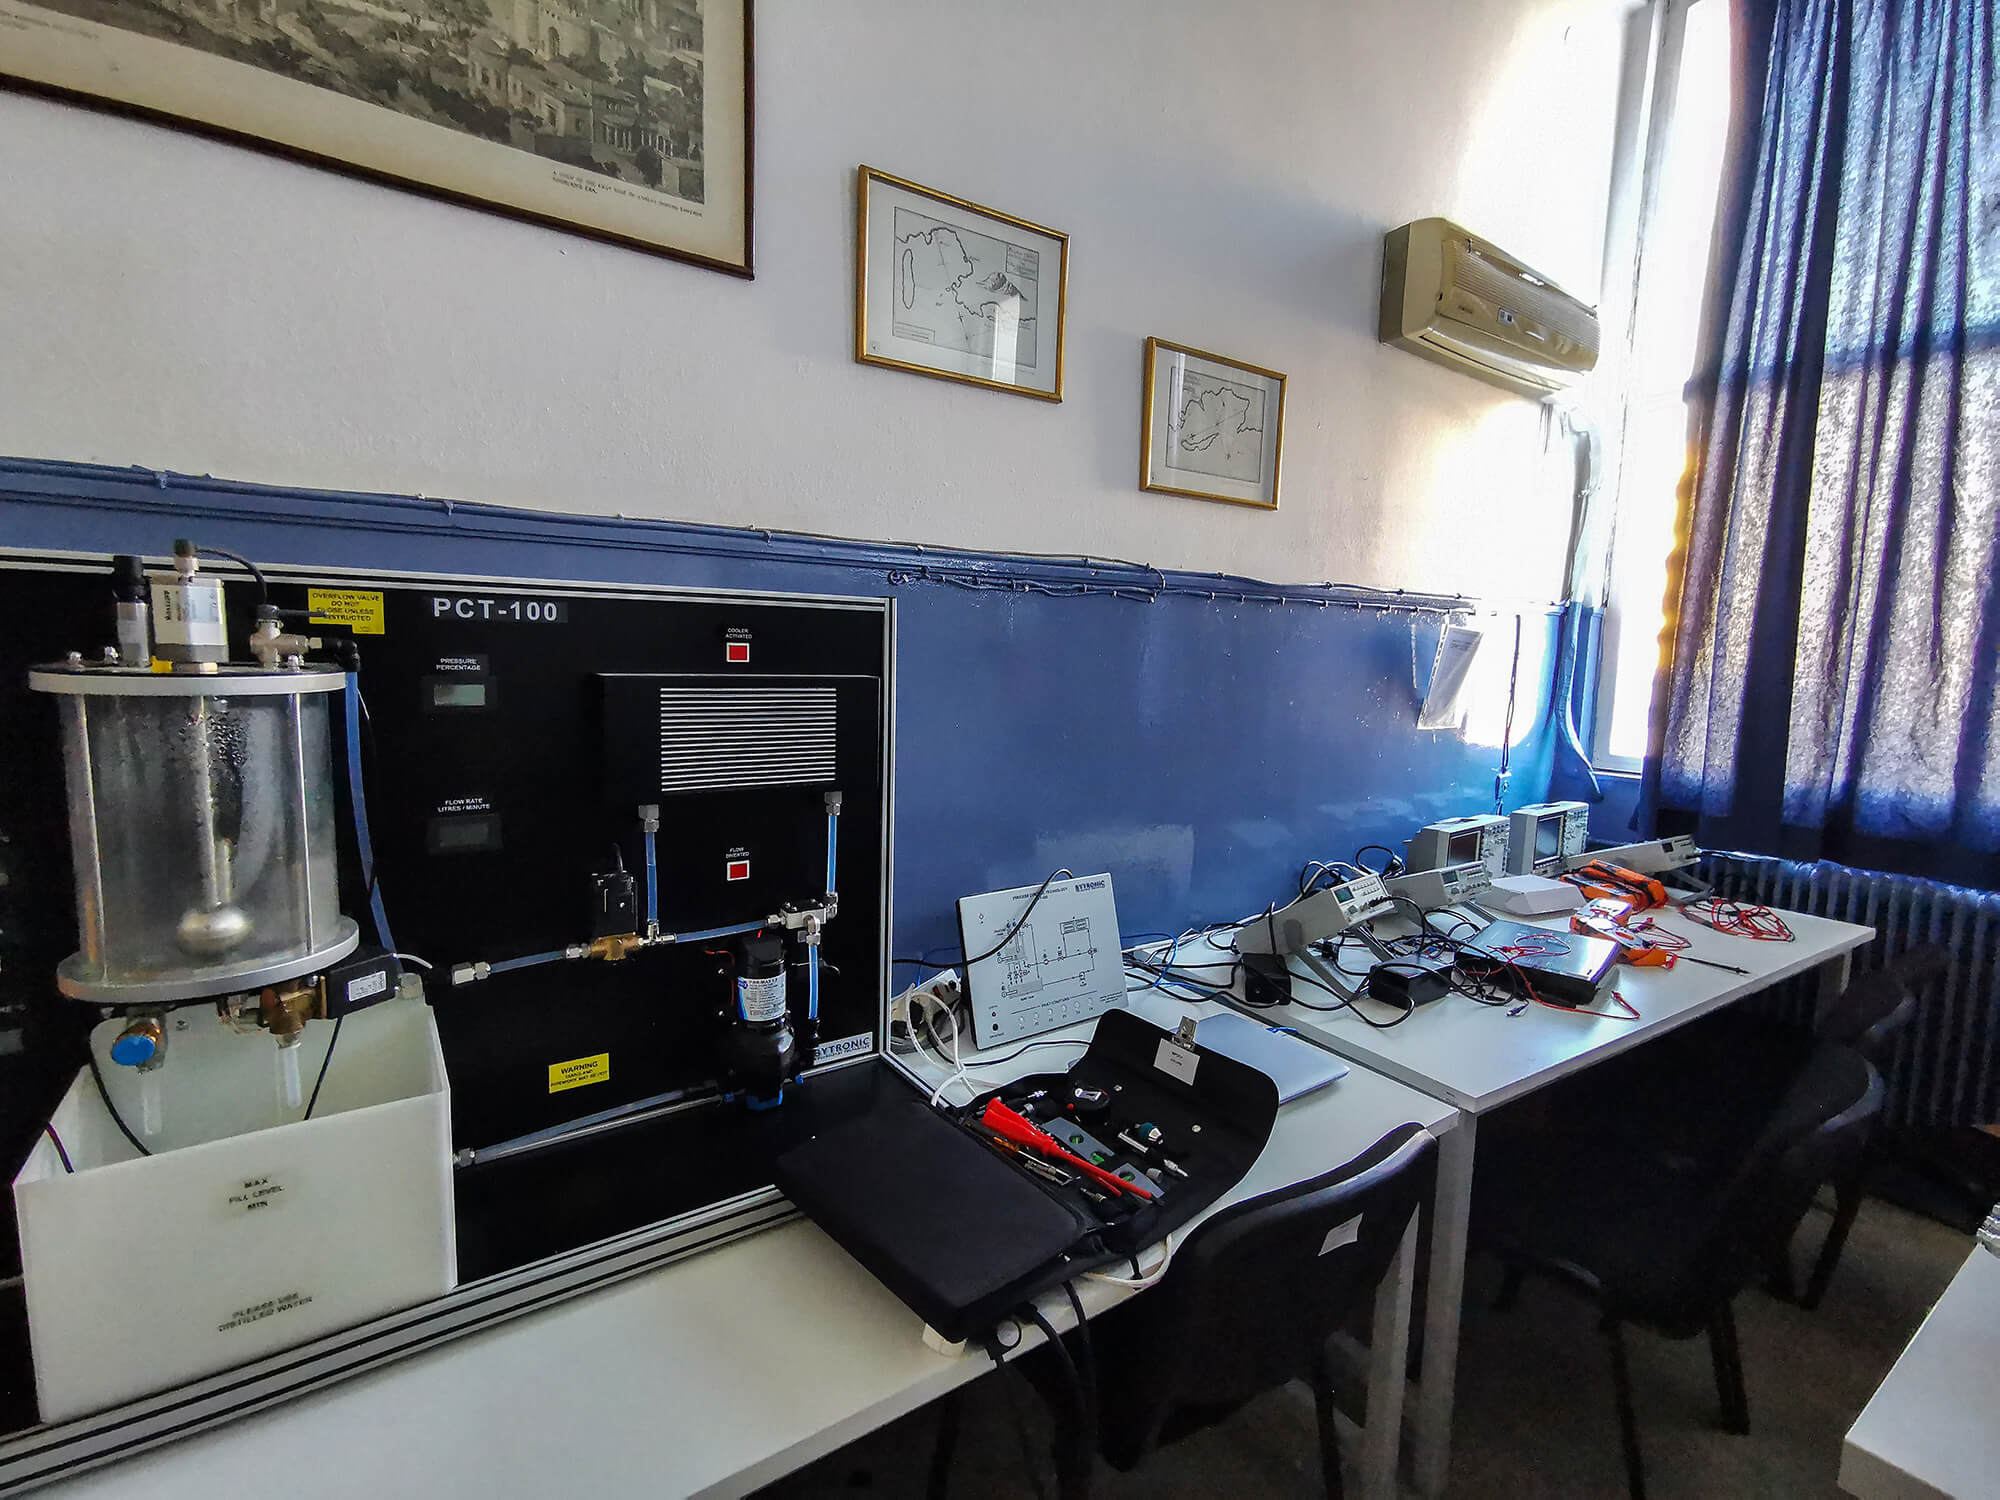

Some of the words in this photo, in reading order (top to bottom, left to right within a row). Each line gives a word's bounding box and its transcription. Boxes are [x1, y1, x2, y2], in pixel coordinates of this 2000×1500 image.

[312, 592, 355, 601] OVERFLOW
[433, 597, 557, 621] PCT-100
[437, 805, 461, 813] LITRES
[560, 1060, 599, 1075] WARNING
[244, 1178, 268, 1188] MAX
